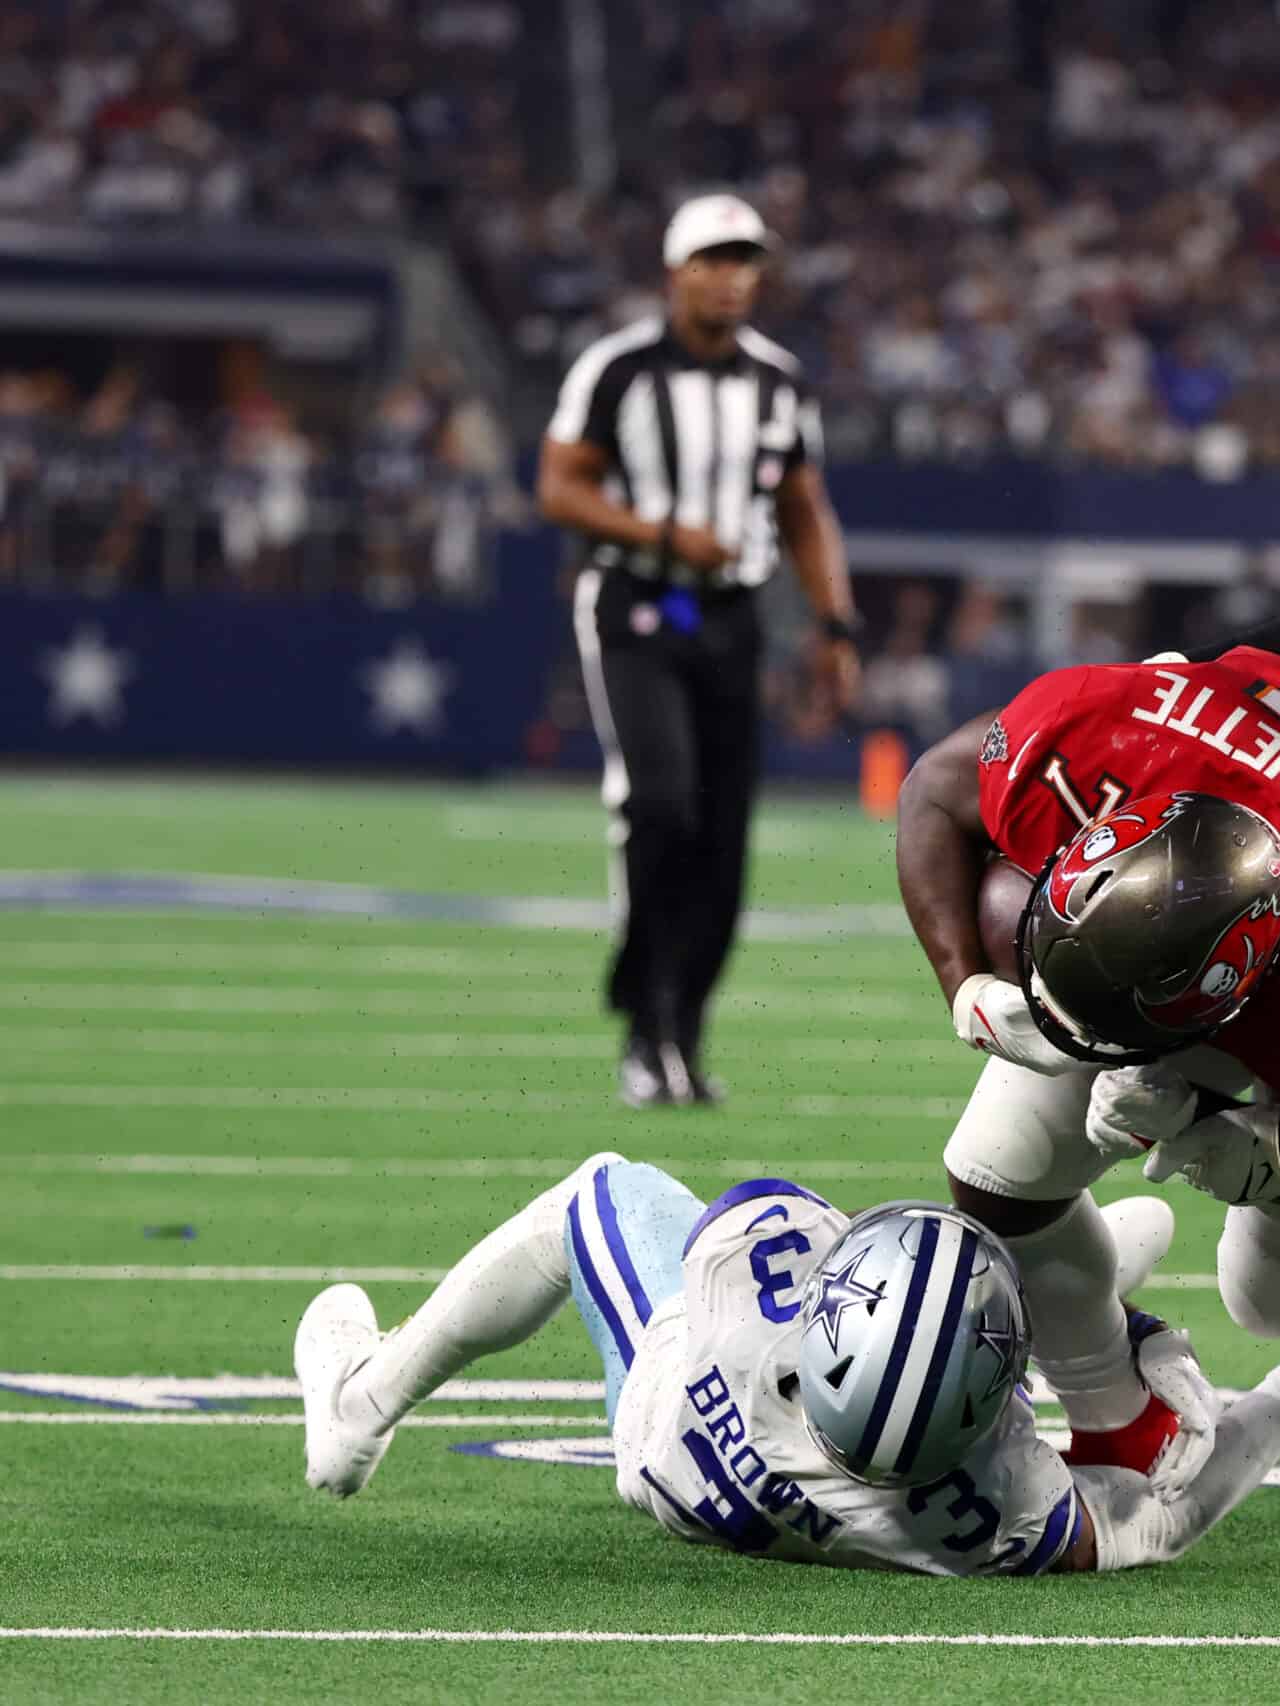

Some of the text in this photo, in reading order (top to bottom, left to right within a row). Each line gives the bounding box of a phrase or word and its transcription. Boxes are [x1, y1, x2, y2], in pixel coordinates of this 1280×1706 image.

[748, 1230, 811, 1325] 3
[685, 1364, 844, 1545] BROWN
[906, 1468, 1001, 1552] 3
